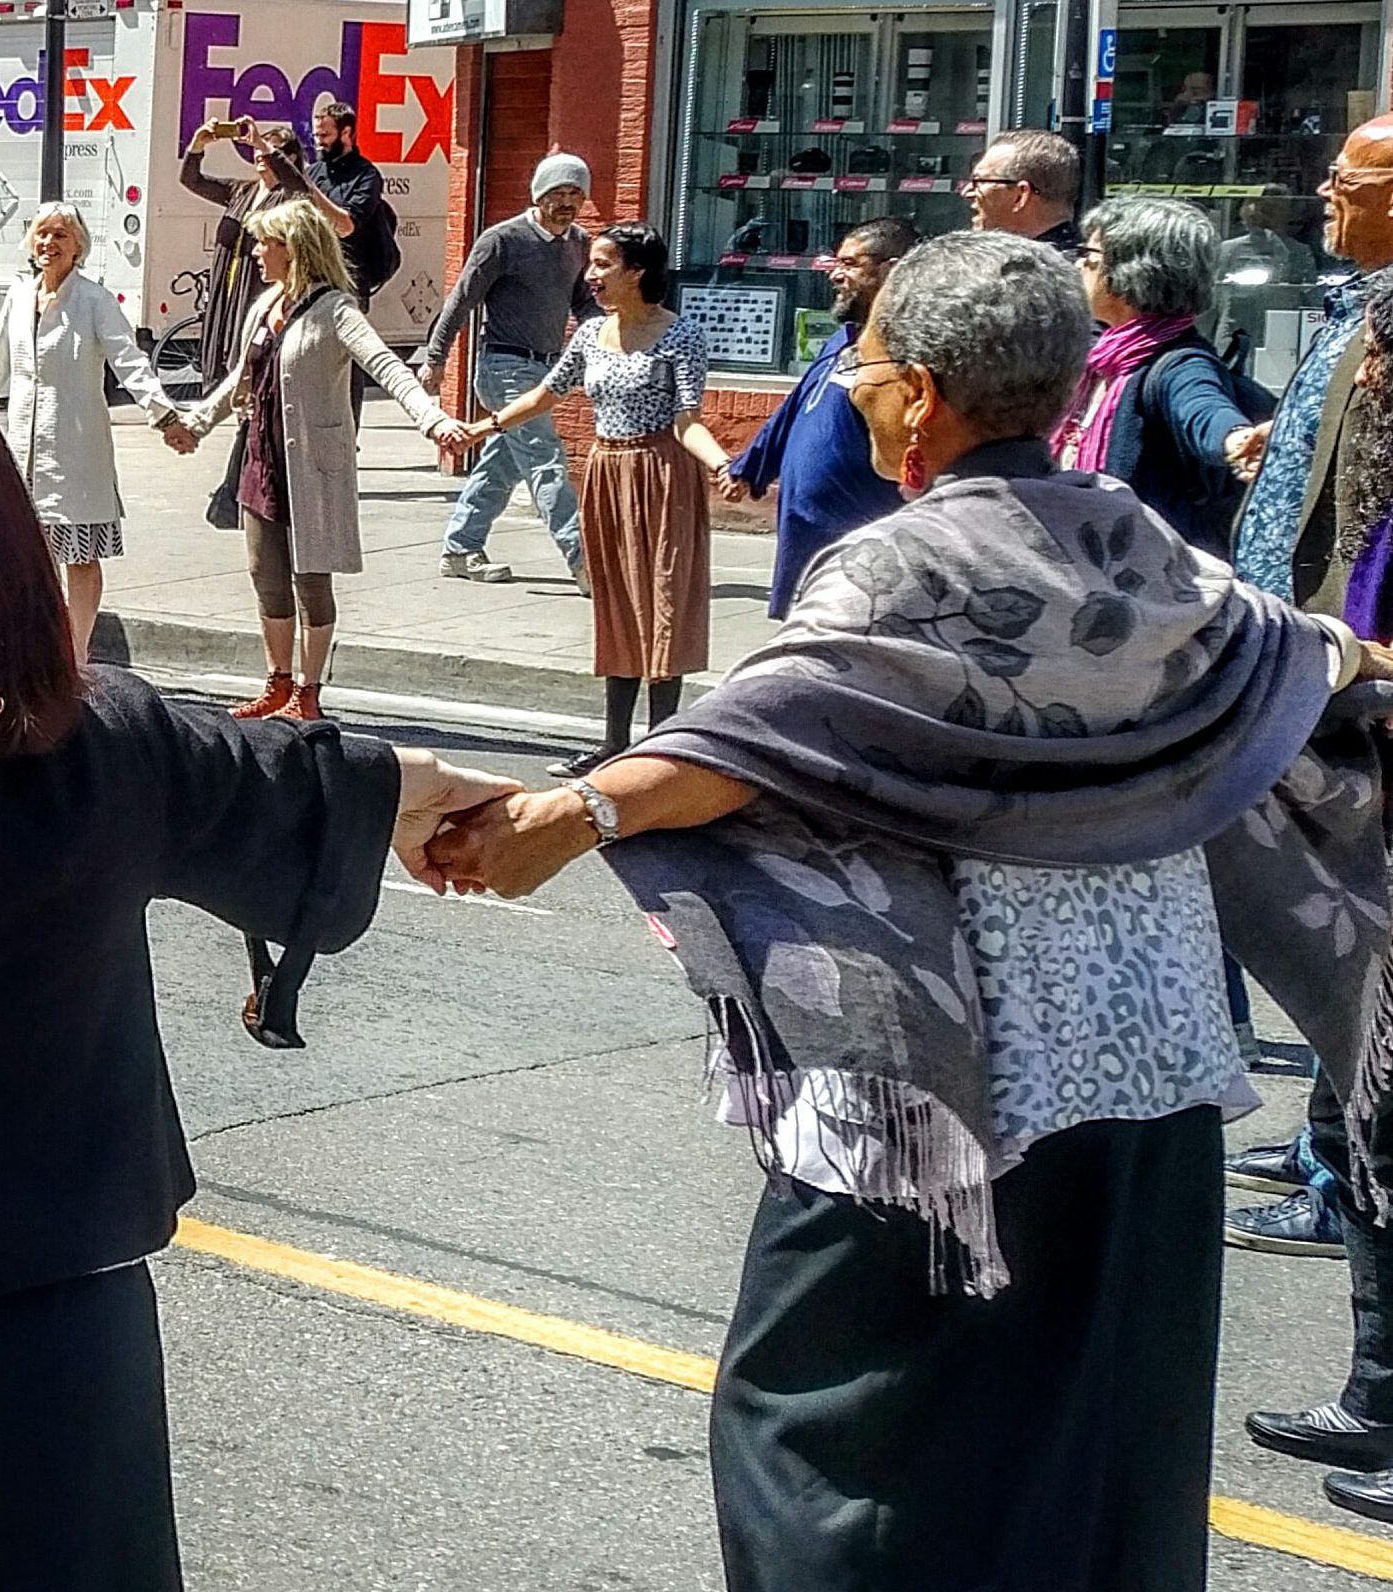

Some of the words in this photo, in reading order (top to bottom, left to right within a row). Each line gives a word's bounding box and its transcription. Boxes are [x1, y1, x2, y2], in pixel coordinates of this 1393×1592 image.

[178, 11, 455, 165] FedEx
[64, 143, 98, 160] press
[382, 177, 410, 195] ress
[397, 220, 421, 237] edEx
